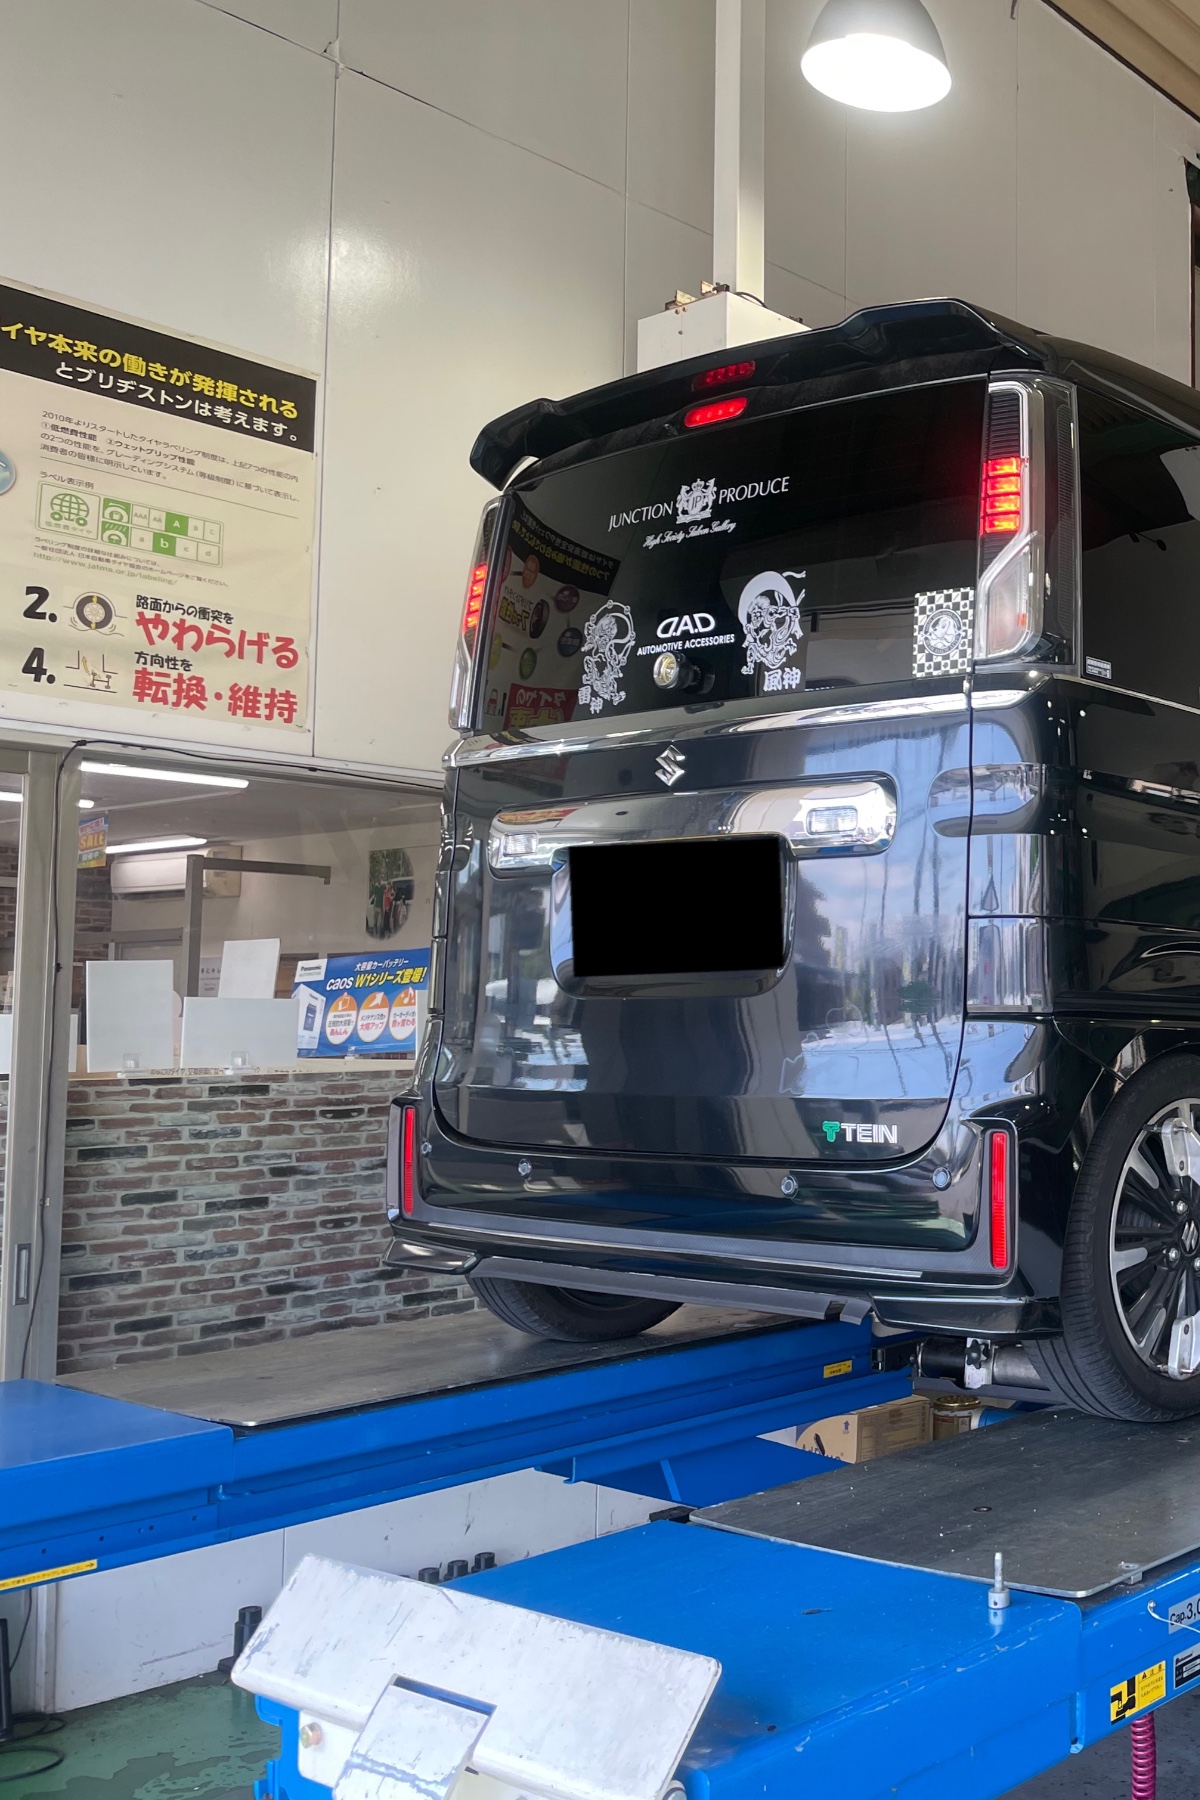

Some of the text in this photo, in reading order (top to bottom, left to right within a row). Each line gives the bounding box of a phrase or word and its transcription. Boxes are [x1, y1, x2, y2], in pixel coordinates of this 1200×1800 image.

[1, 322, 298, 420] イヤ本来の働きが発揮される
[55, 361, 297, 442] とブリヂストンは考えます。
[39, 470, 94, 490] ラベル表示例
[607, 501, 674, 532] JUNCTION
[718, 476, 790, 505] PRODUCE
[173, 520, 180, 528] A
[160, 538, 169, 549] b
[22, 585, 58, 623] 2.
[135, 594, 234, 625] 路面からの衝突を
[135, 611, 299, 669] やわらげる
[636, 633, 736, 656] AUTOMOTIVE ACCESSORIES
[21, 646, 57, 685] 4.
[134, 651, 193, 672] 方向性を
[763, 666, 802, 692] 風神
[132, 667, 298, 724] 転換・維持
[80, 831, 105, 850] SALE
[354, 957, 409, 972] 大容量カーバッテリー
[326, 966, 428, 991] caos W1シリーズ登場!
[840, 1122, 898, 1144] TEIN
